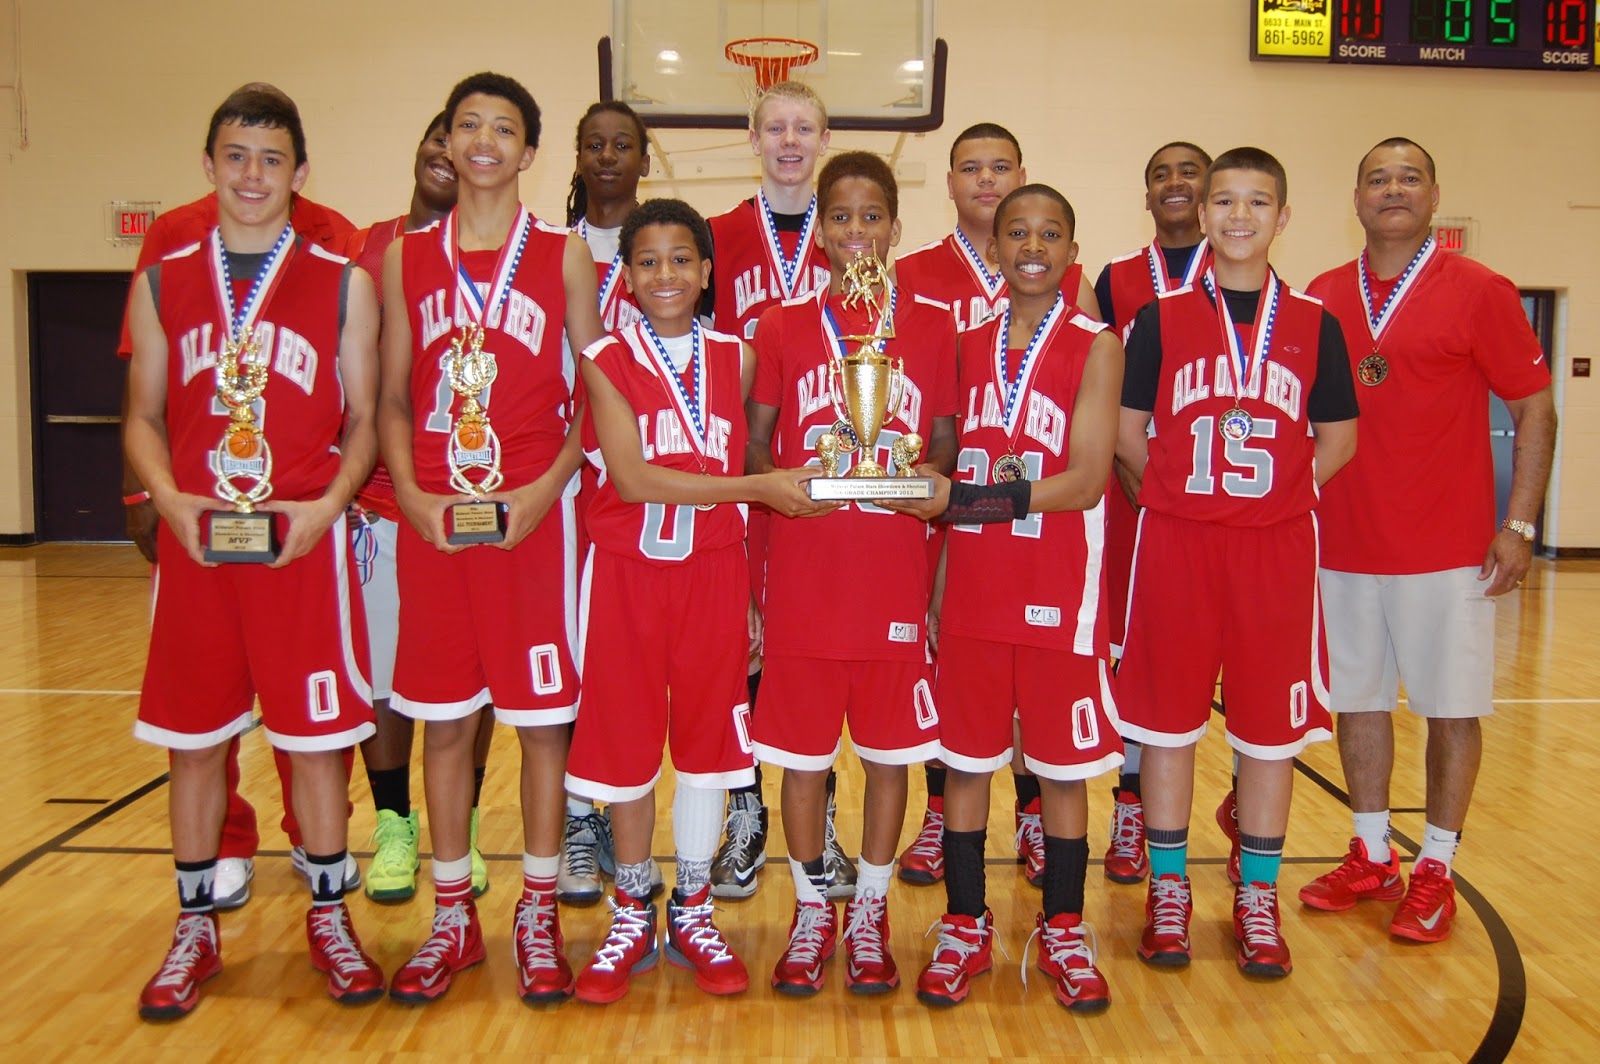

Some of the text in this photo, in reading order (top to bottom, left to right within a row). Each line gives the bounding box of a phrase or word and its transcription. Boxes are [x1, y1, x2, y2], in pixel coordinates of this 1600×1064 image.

[1264, 30, 1324, 46] 861-5962
[1294, 18, 1311, 27] MAIN
[1547, 0, 1587, 45] 10
[1339, 45, 1386, 58] SCORE
[1419, 47, 1465, 60] MATCH
[1542, 51, 1589, 64] SCORE
[121, 212, 148, 234] EXIT
[1437, 228, 1463, 249] EXIT
[734, 265, 767, 319] ALL
[419, 288, 452, 351] ALL
[503, 288, 546, 356] RED
[181, 322, 217, 387] ALL
[274, 326, 318, 396] RED
[797, 364, 831, 427] ALL
[886, 373, 922, 433] RED
[1172, 357, 1210, 416] ALL
[1264, 360, 1301, 422] RED
[1024, 388, 1066, 457] RED
[1185, 415, 1277, 498] 15
